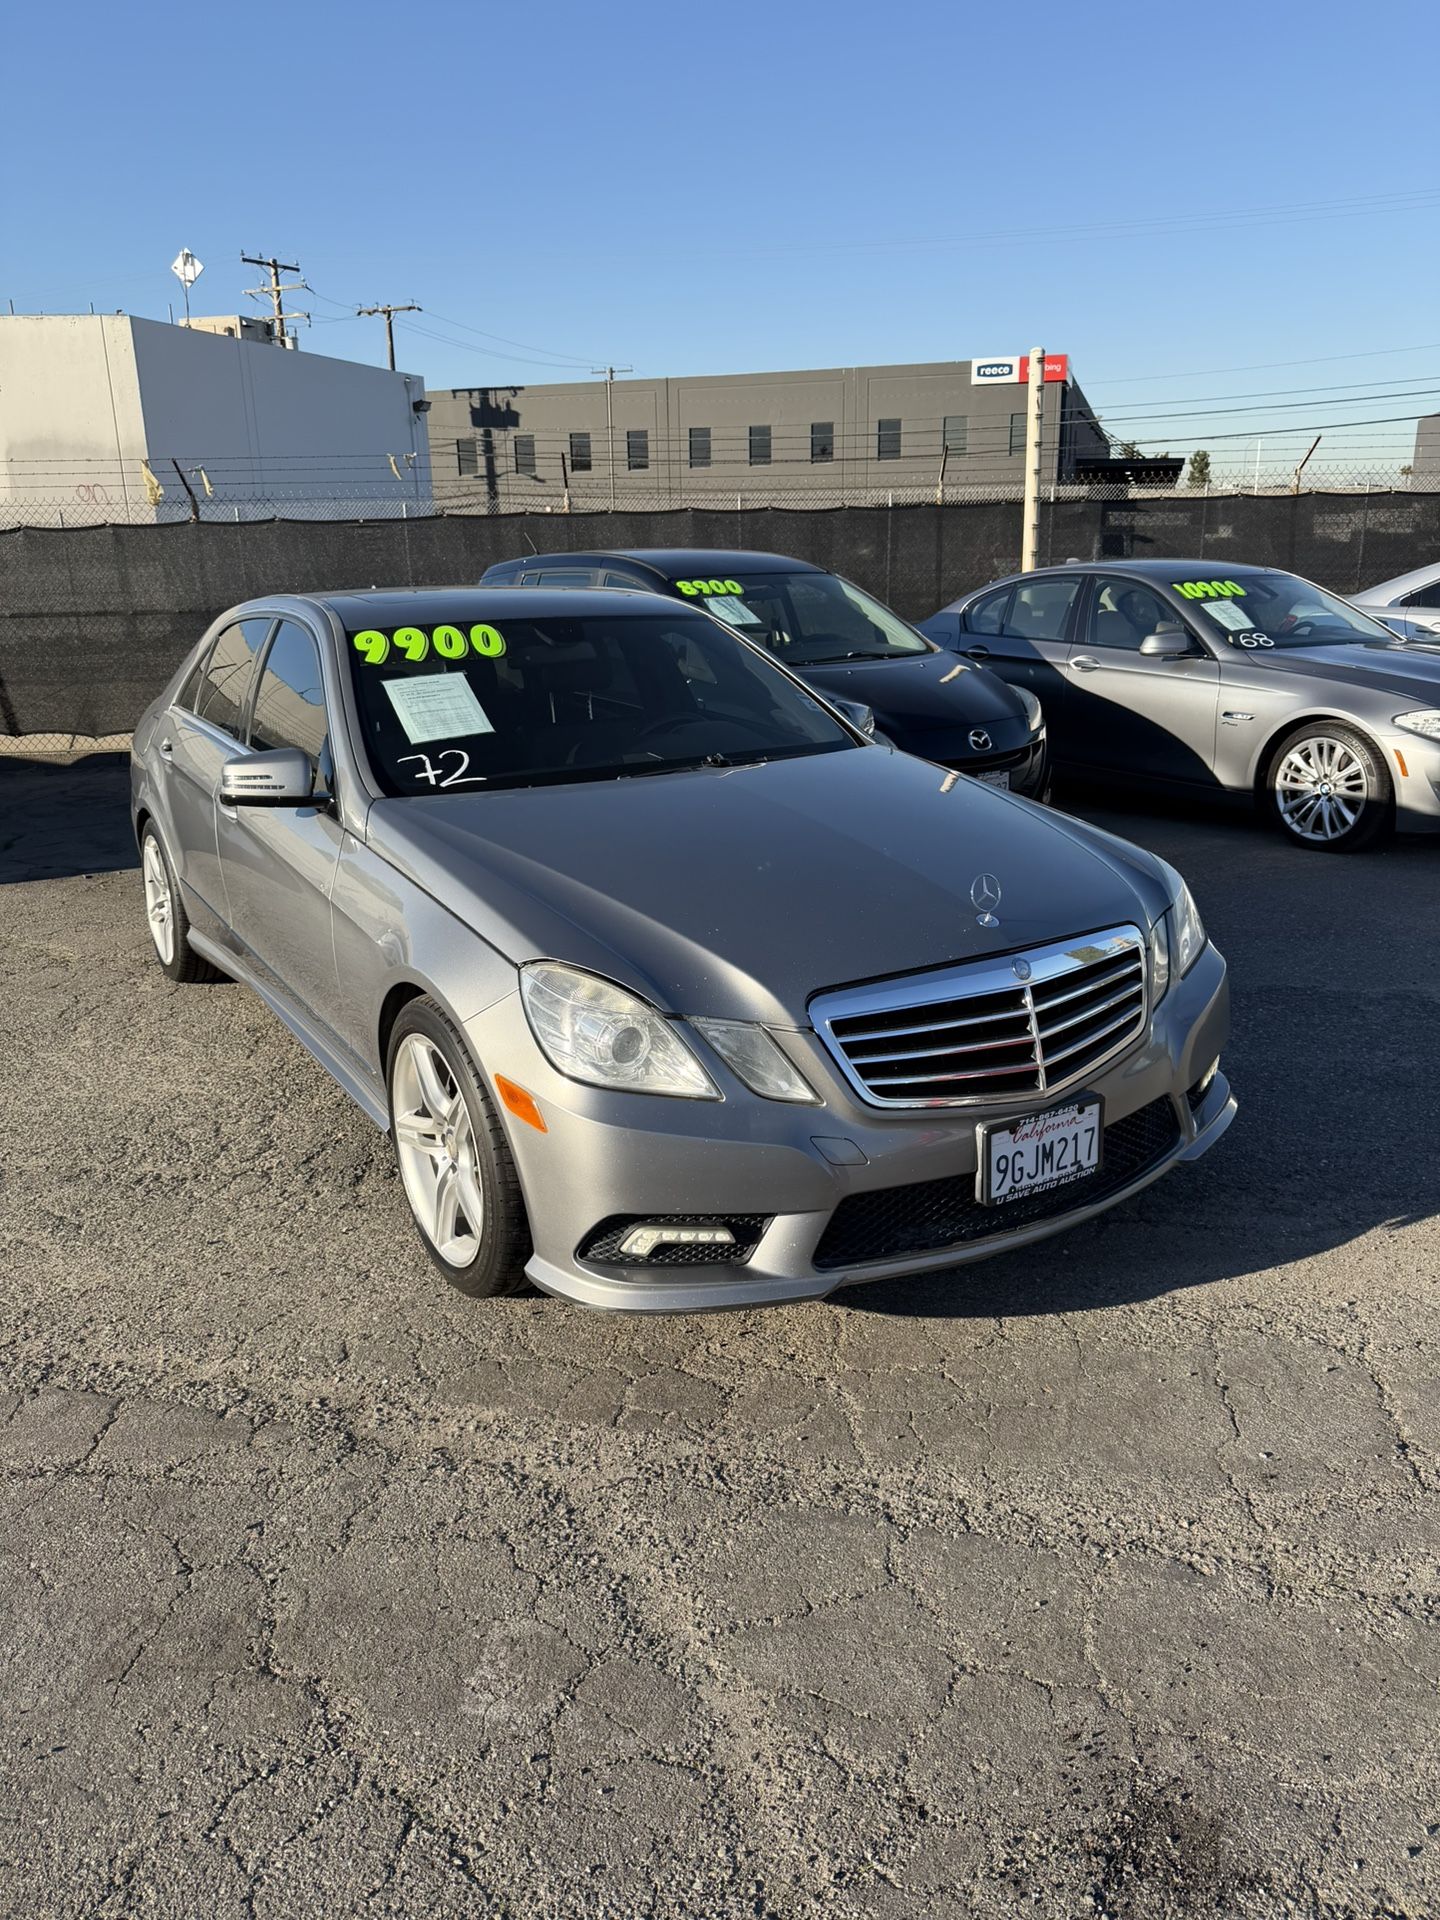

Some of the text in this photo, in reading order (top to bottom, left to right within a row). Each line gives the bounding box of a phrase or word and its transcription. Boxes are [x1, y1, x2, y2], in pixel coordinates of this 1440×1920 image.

[676, 579, 744, 595] 8900
[1172, 580, 1247, 599] 10900
[353, 624, 506, 665] 9900
[1239, 633, 1275, 648] 68
[397, 749, 487, 788] 72
[1012, 1115, 1084, 1144] California
[995, 1126, 1095, 1191] 9GJM217
[996, 1166, 1096, 1205] U SAVE AUTO AUCTION
